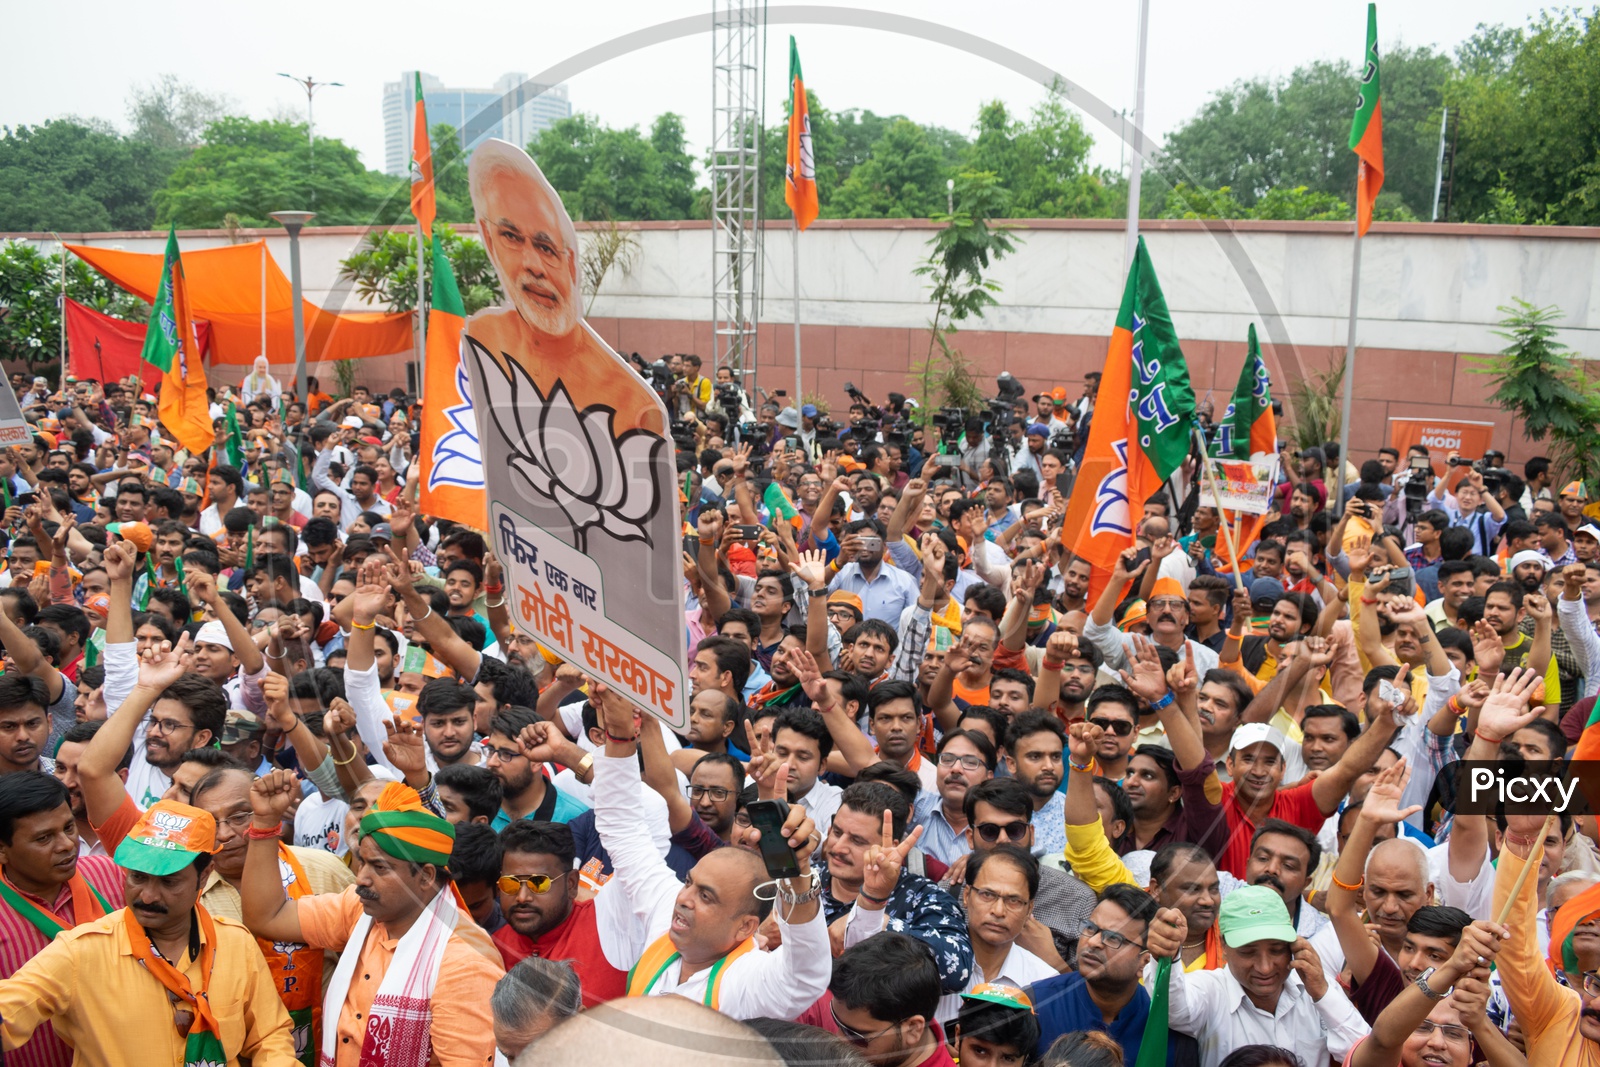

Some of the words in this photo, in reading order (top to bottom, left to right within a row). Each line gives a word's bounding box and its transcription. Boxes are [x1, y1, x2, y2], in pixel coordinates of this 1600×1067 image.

[1421, 435, 1462, 449] MODI
[1426, 428, 1462, 436] SUPPORT
[499, 513, 539, 576] फिर
[544, 560, 568, 592] एक
[571, 577, 597, 612] बार
[517, 581, 574, 654] मोदी
[579, 624, 675, 717] सरकार
